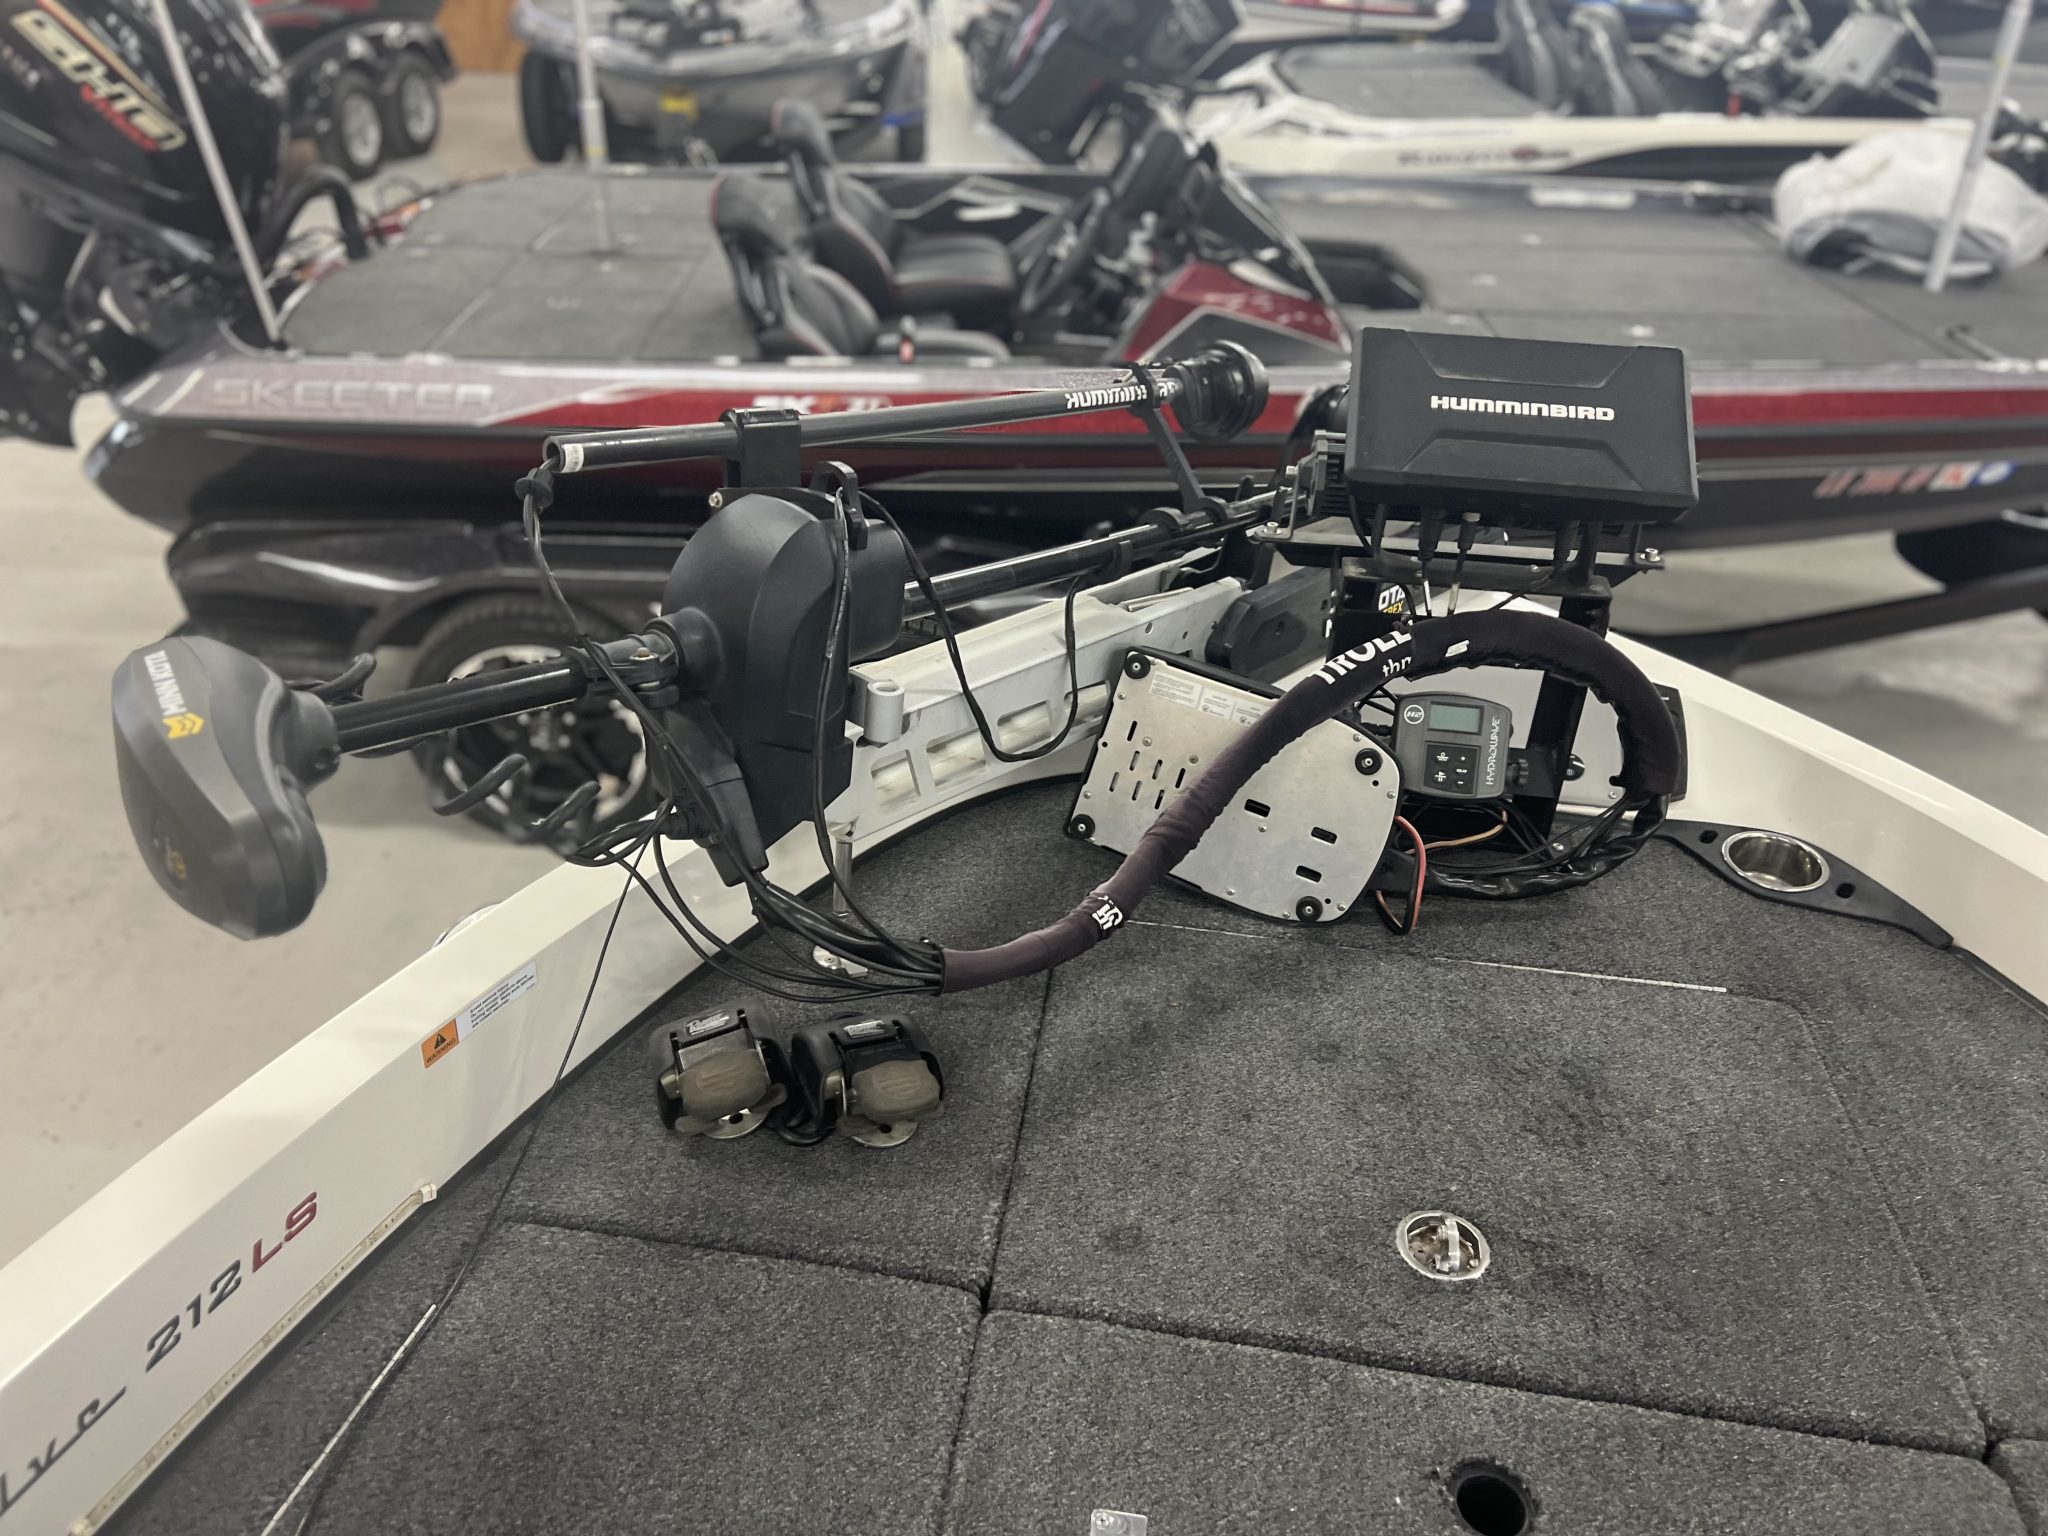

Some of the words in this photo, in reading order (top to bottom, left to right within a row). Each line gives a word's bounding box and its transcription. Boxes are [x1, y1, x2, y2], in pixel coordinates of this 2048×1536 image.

[1430, 395, 1615, 421] HUMMINBIRD
[1378, 584, 1406, 611] OTA
[144, 650, 176, 681] KOTA
[154, 678, 187, 716] MINN
[1485, 716, 1501, 785] HYDROWAVE
[425, 1037, 457, 1064] WARNING
[145, 1259, 242, 1373] 212
[252, 1191, 317, 1273] LS
